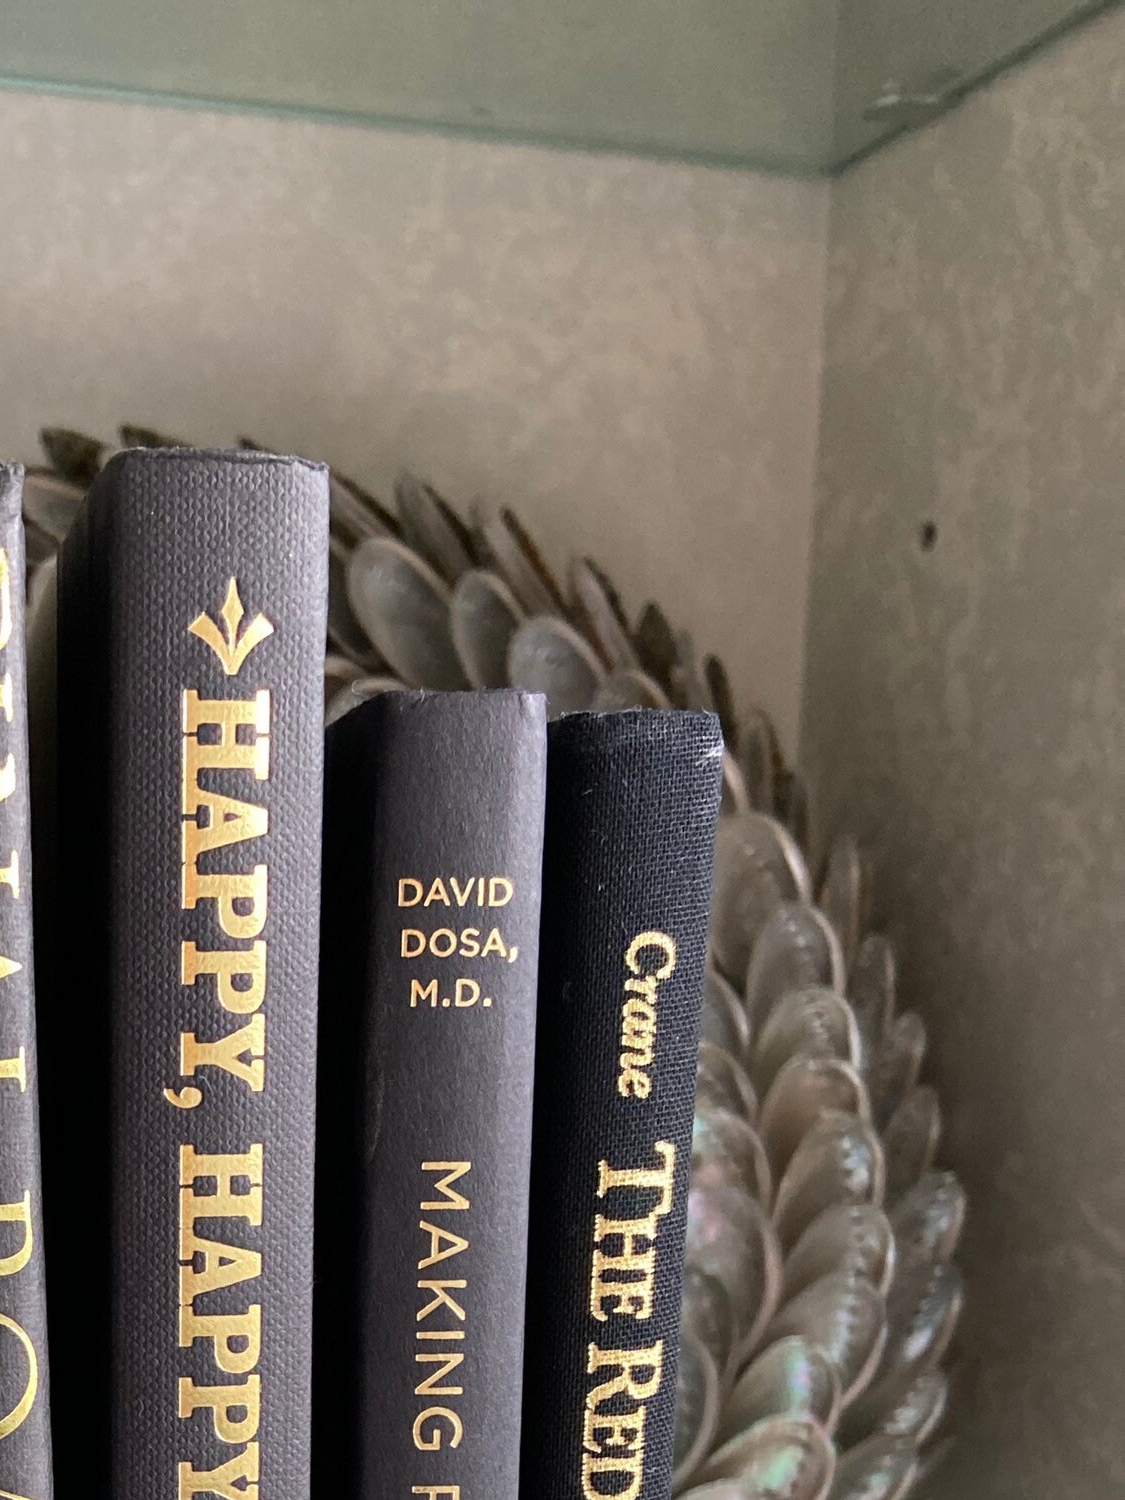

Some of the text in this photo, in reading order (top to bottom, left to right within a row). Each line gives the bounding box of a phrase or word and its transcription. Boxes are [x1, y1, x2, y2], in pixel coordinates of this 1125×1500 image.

[163, 689, 268, 1110] HAPPY,
[397, 877, 513, 908] DAVID
[401, 927, 518, 963] DOSA,
[410, 978, 492, 1008] M.D.
[617, 930, 676, 1098] Crane
[413, 1160, 472, 1453] MAKING
[590, 1141, 675, 1320] THE
